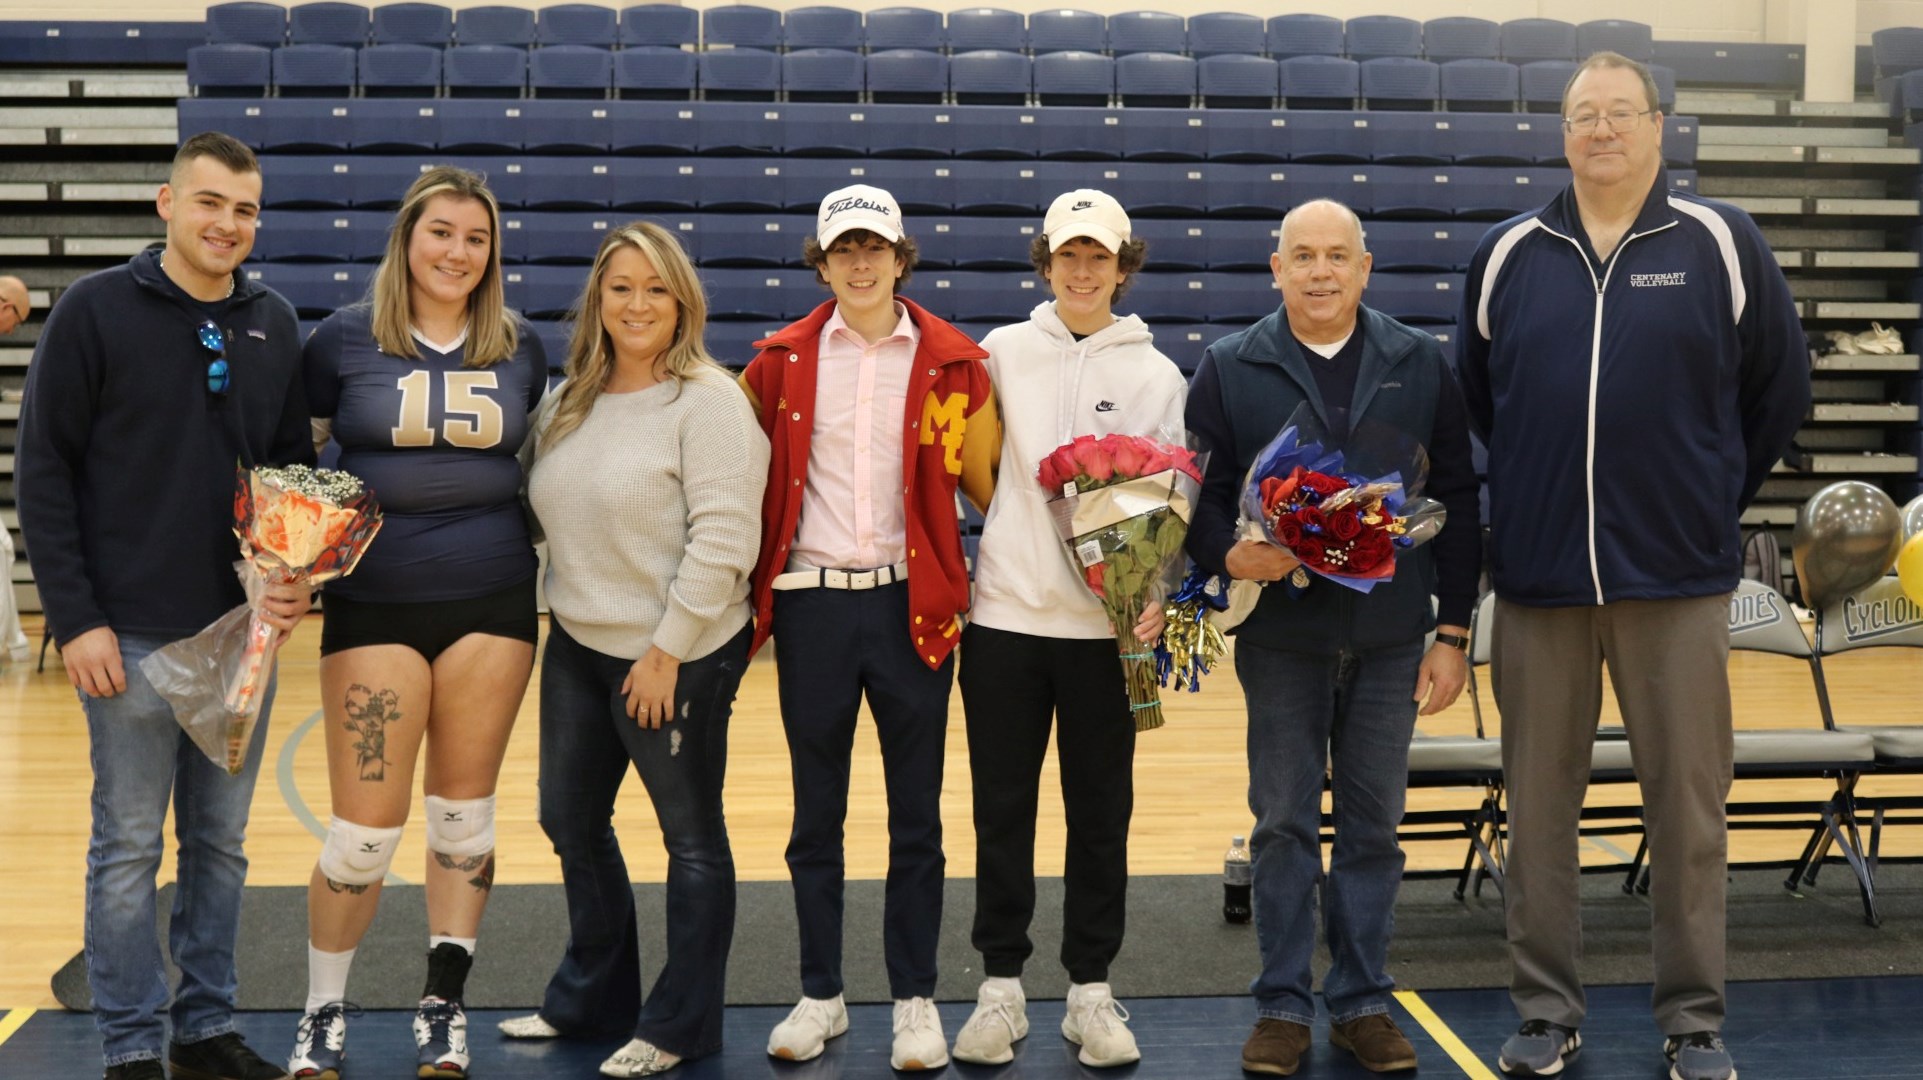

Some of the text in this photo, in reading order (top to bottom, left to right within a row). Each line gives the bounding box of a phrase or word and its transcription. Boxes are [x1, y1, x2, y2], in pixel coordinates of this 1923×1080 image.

[824, 197, 890, 222] Titleist
[1630, 272, 1686, 281] CENTENARY
[1630, 279, 1686, 287] VOLLEYBALL
[392, 370, 503, 449] 15
[1728, 592, 1781, 626] ONES
[1844, 596, 1922, 634] CYCLON
